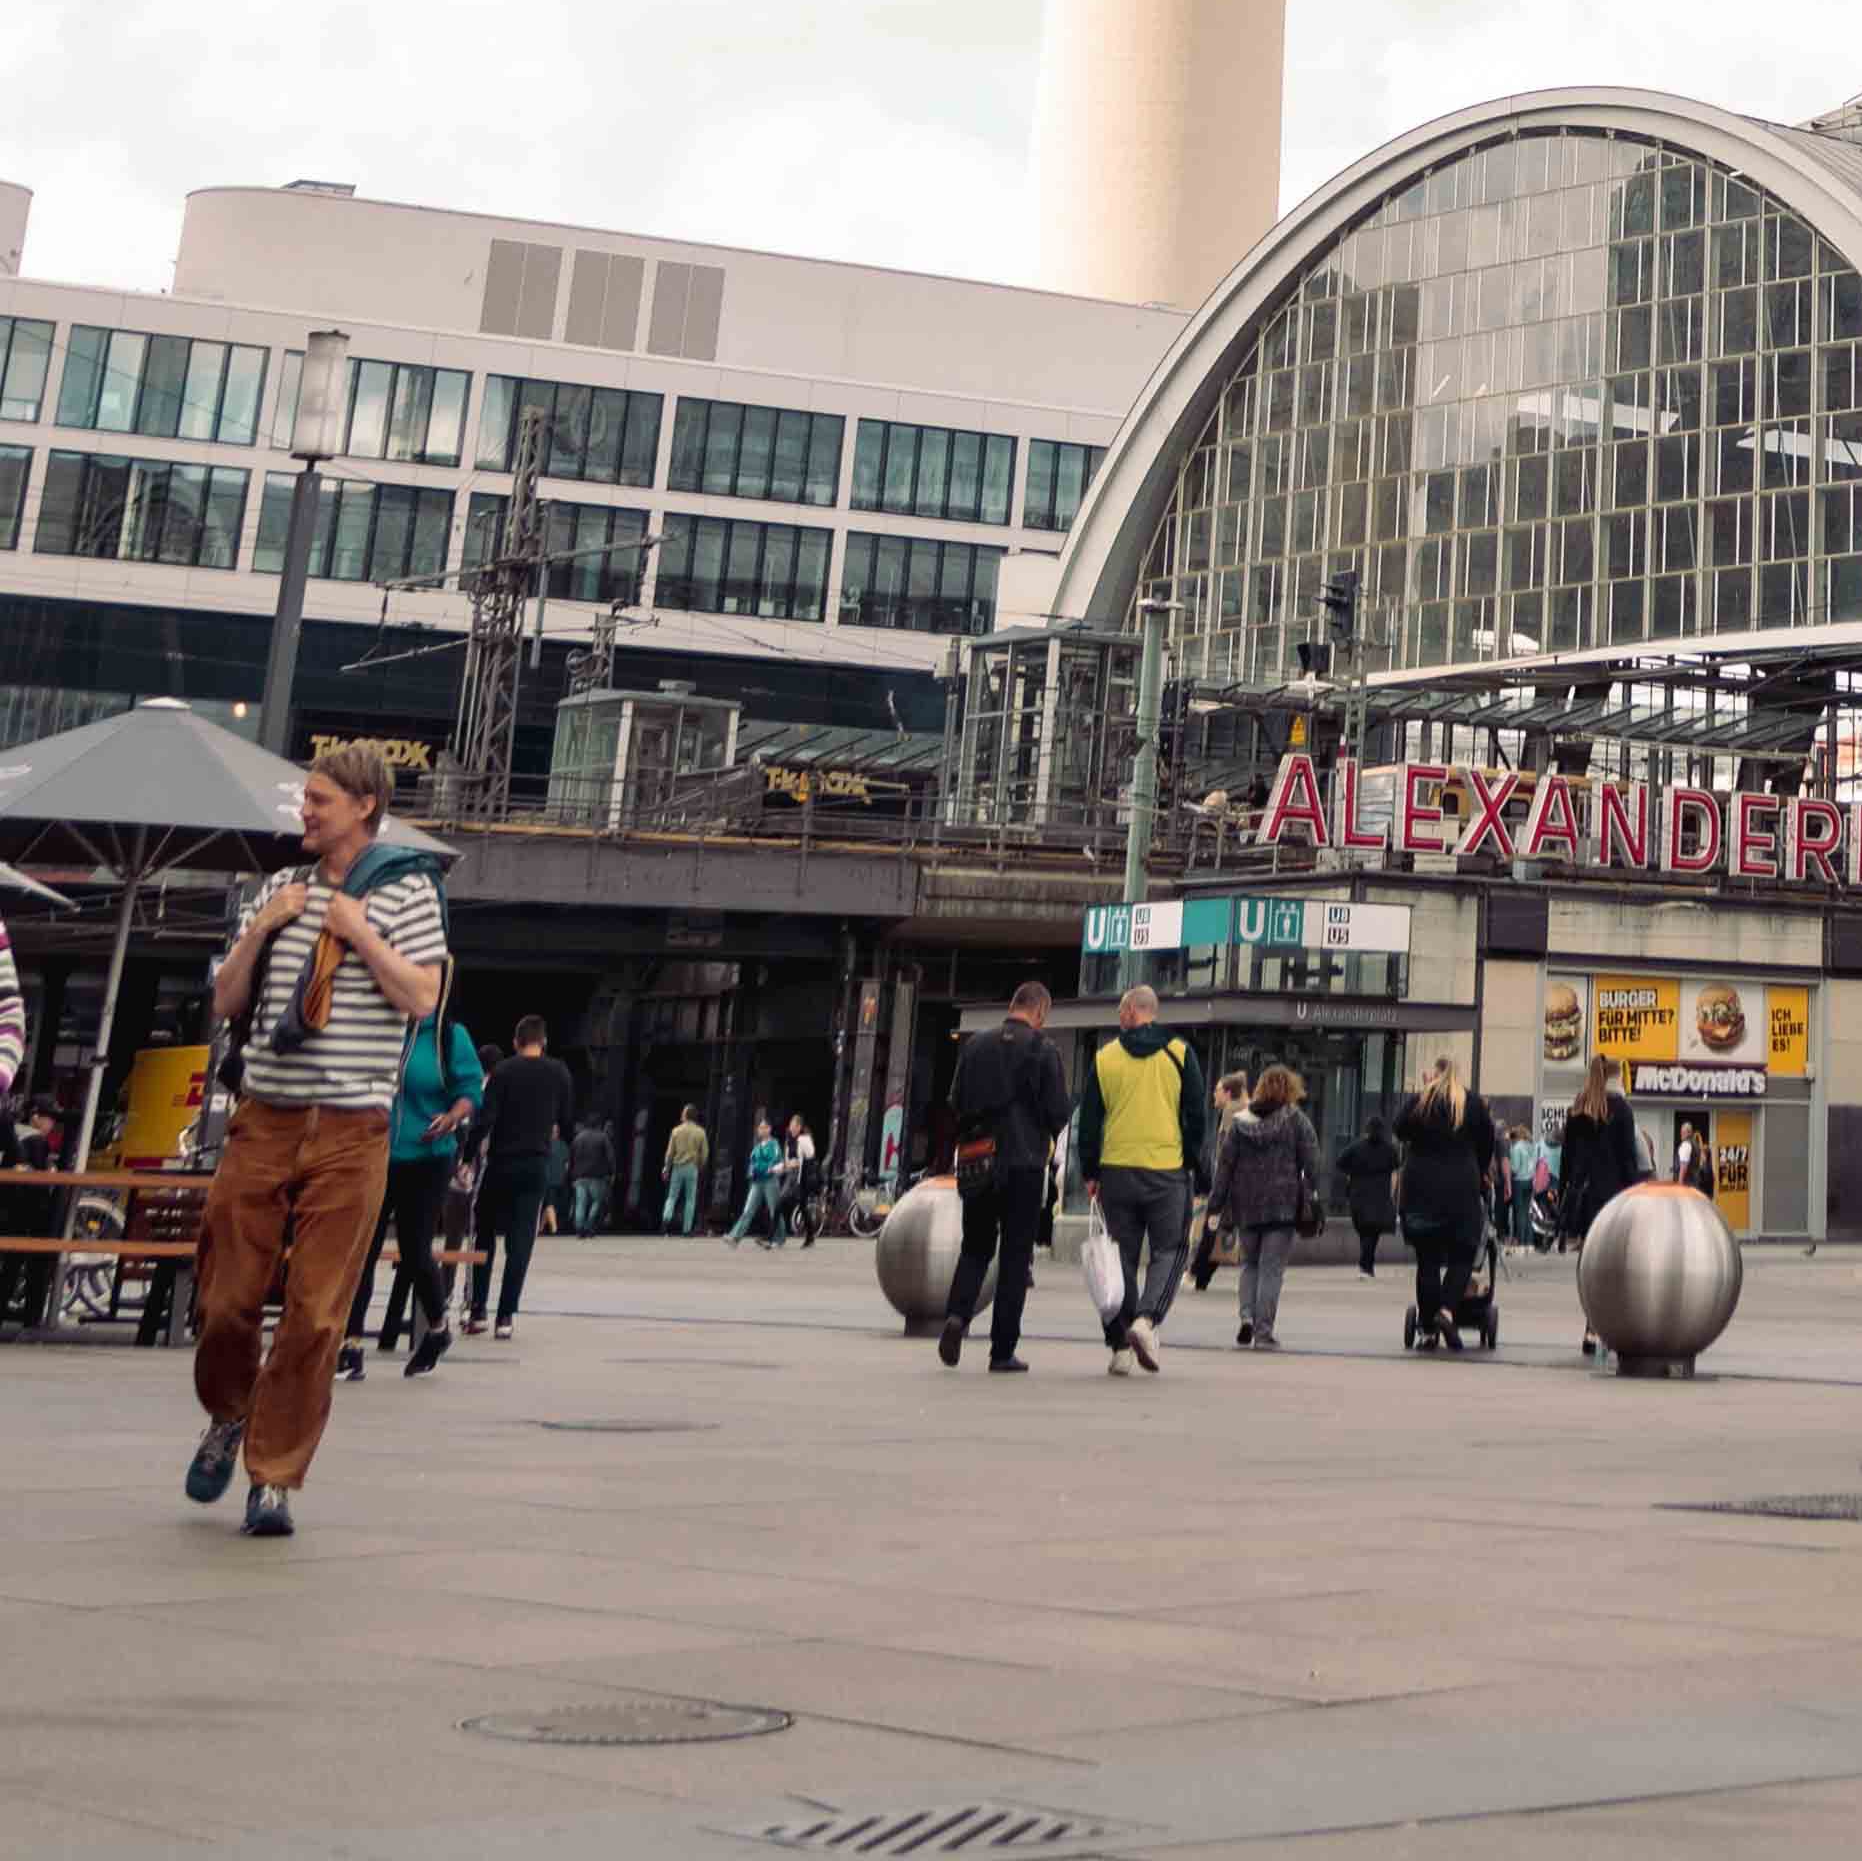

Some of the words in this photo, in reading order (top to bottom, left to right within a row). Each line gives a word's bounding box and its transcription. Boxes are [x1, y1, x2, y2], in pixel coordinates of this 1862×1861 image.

[1087, 908, 1107, 948] U
[1239, 900, 1265, 941] U
[1599, 989, 1658, 1007] BURGER
[1627, 1009, 1674, 1026] MITTE?
[1771, 1009, 1791, 1020] ICH
[1599, 1027, 1640, 1043] BITTE!
[1771, 1023, 1804, 1036] LIEBE
[1772, 1038, 1790, 1051] ES!
[1635, 1066, 1766, 1094] McDonald's
[1719, 1146, 1748, 1160] 24/7
